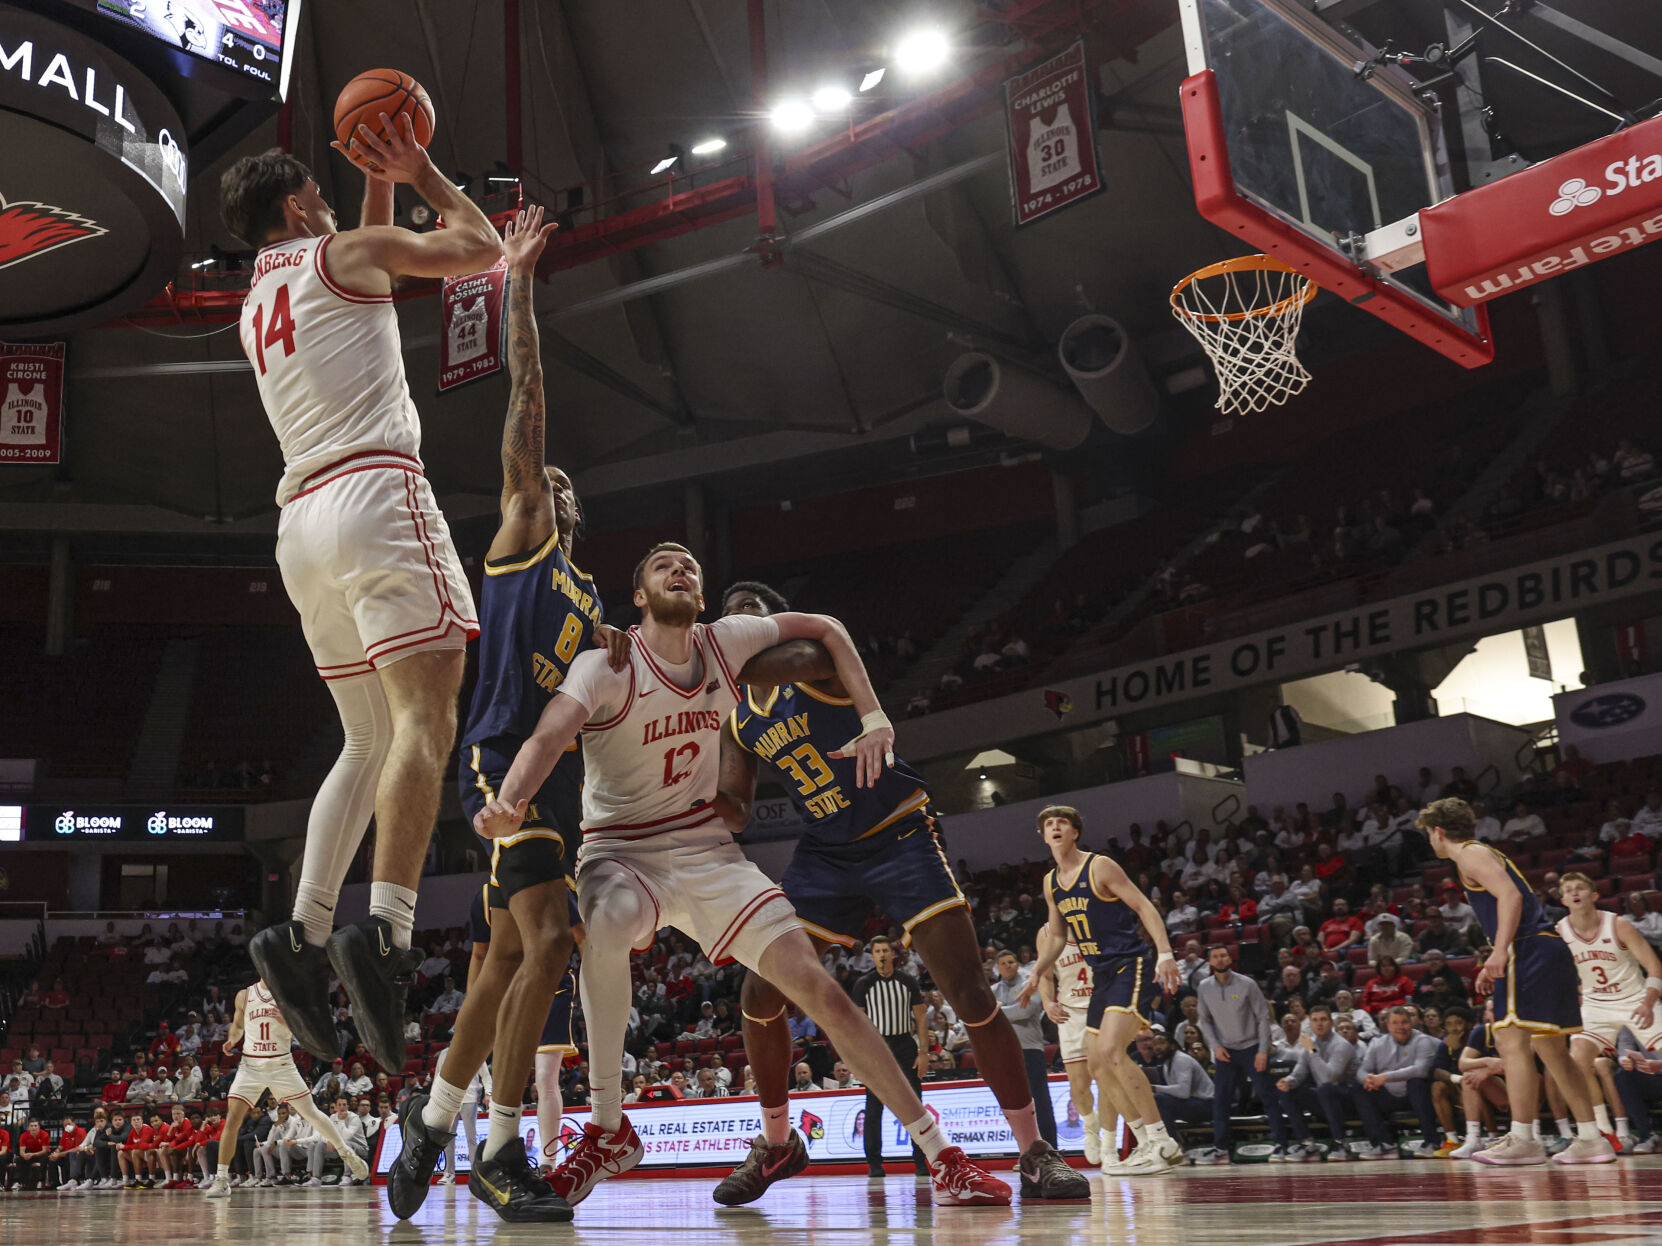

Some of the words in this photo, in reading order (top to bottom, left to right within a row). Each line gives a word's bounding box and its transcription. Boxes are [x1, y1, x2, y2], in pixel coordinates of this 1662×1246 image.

[222, 32, 235, 49] 4
[252, 44, 267, 61] 0
[218, 53, 238, 68] TOL
[243, 64, 271, 81] FOUL
[0, 40, 136, 134] MALL
[1014, 70, 1079, 110] CHARLOTTE
[1030, 90, 1066, 114] LEWIS
[1041, 138, 1065, 163] 30
[448, 284, 493, 303] BOSWELL
[455, 277, 489, 292] CATHY
[252, 282, 297, 377] 14
[457, 322, 477, 340] 44
[7, 371, 47, 379] CIRONE
[10, 363, 44, 371] KRISTI
[8, 399, 42, 411] ILLINOIS
[16, 409, 34, 424] 10
[11, 426, 36, 435] STATE
[0, 449, 51, 457] 005-2009
[1096, 654, 1211, 711] HOME
[1230, 637, 1286, 677] OF
[1305, 609, 1391, 659] THE
[1414, 541, 1662, 636] REDBIRDS
[554, 612, 584, 664] 8
[642, 710, 720, 746] ILLINOIS
[753, 712, 811, 763] MURRAY
[663, 741, 700, 787] 12
[775, 742, 835, 796] 33
[756, 803, 787, 820] OSF
[76, 816, 122, 829] BLOOM
[168, 817, 213, 829] BLOOM
[1065, 913, 1092, 940] 77
[1058, 952, 1085, 968] ILLIN
[1077, 967, 1088, 984] 4
[1591, 965, 1608, 985] 3
[1070, 987, 1093, 997] STAT
[260, 1021, 270, 1041] 11
[253, 1042, 277, 1052] STATE
[658, 1123, 688, 1134] REAL
[692, 1120, 733, 1133] ESTATE
[738, 1118, 762, 1131] TEA
[656, 1140, 690, 1153] STATE
[693, 1137, 752, 1151] ATHLETIC
[988, 1130, 1014, 1142] RISI
